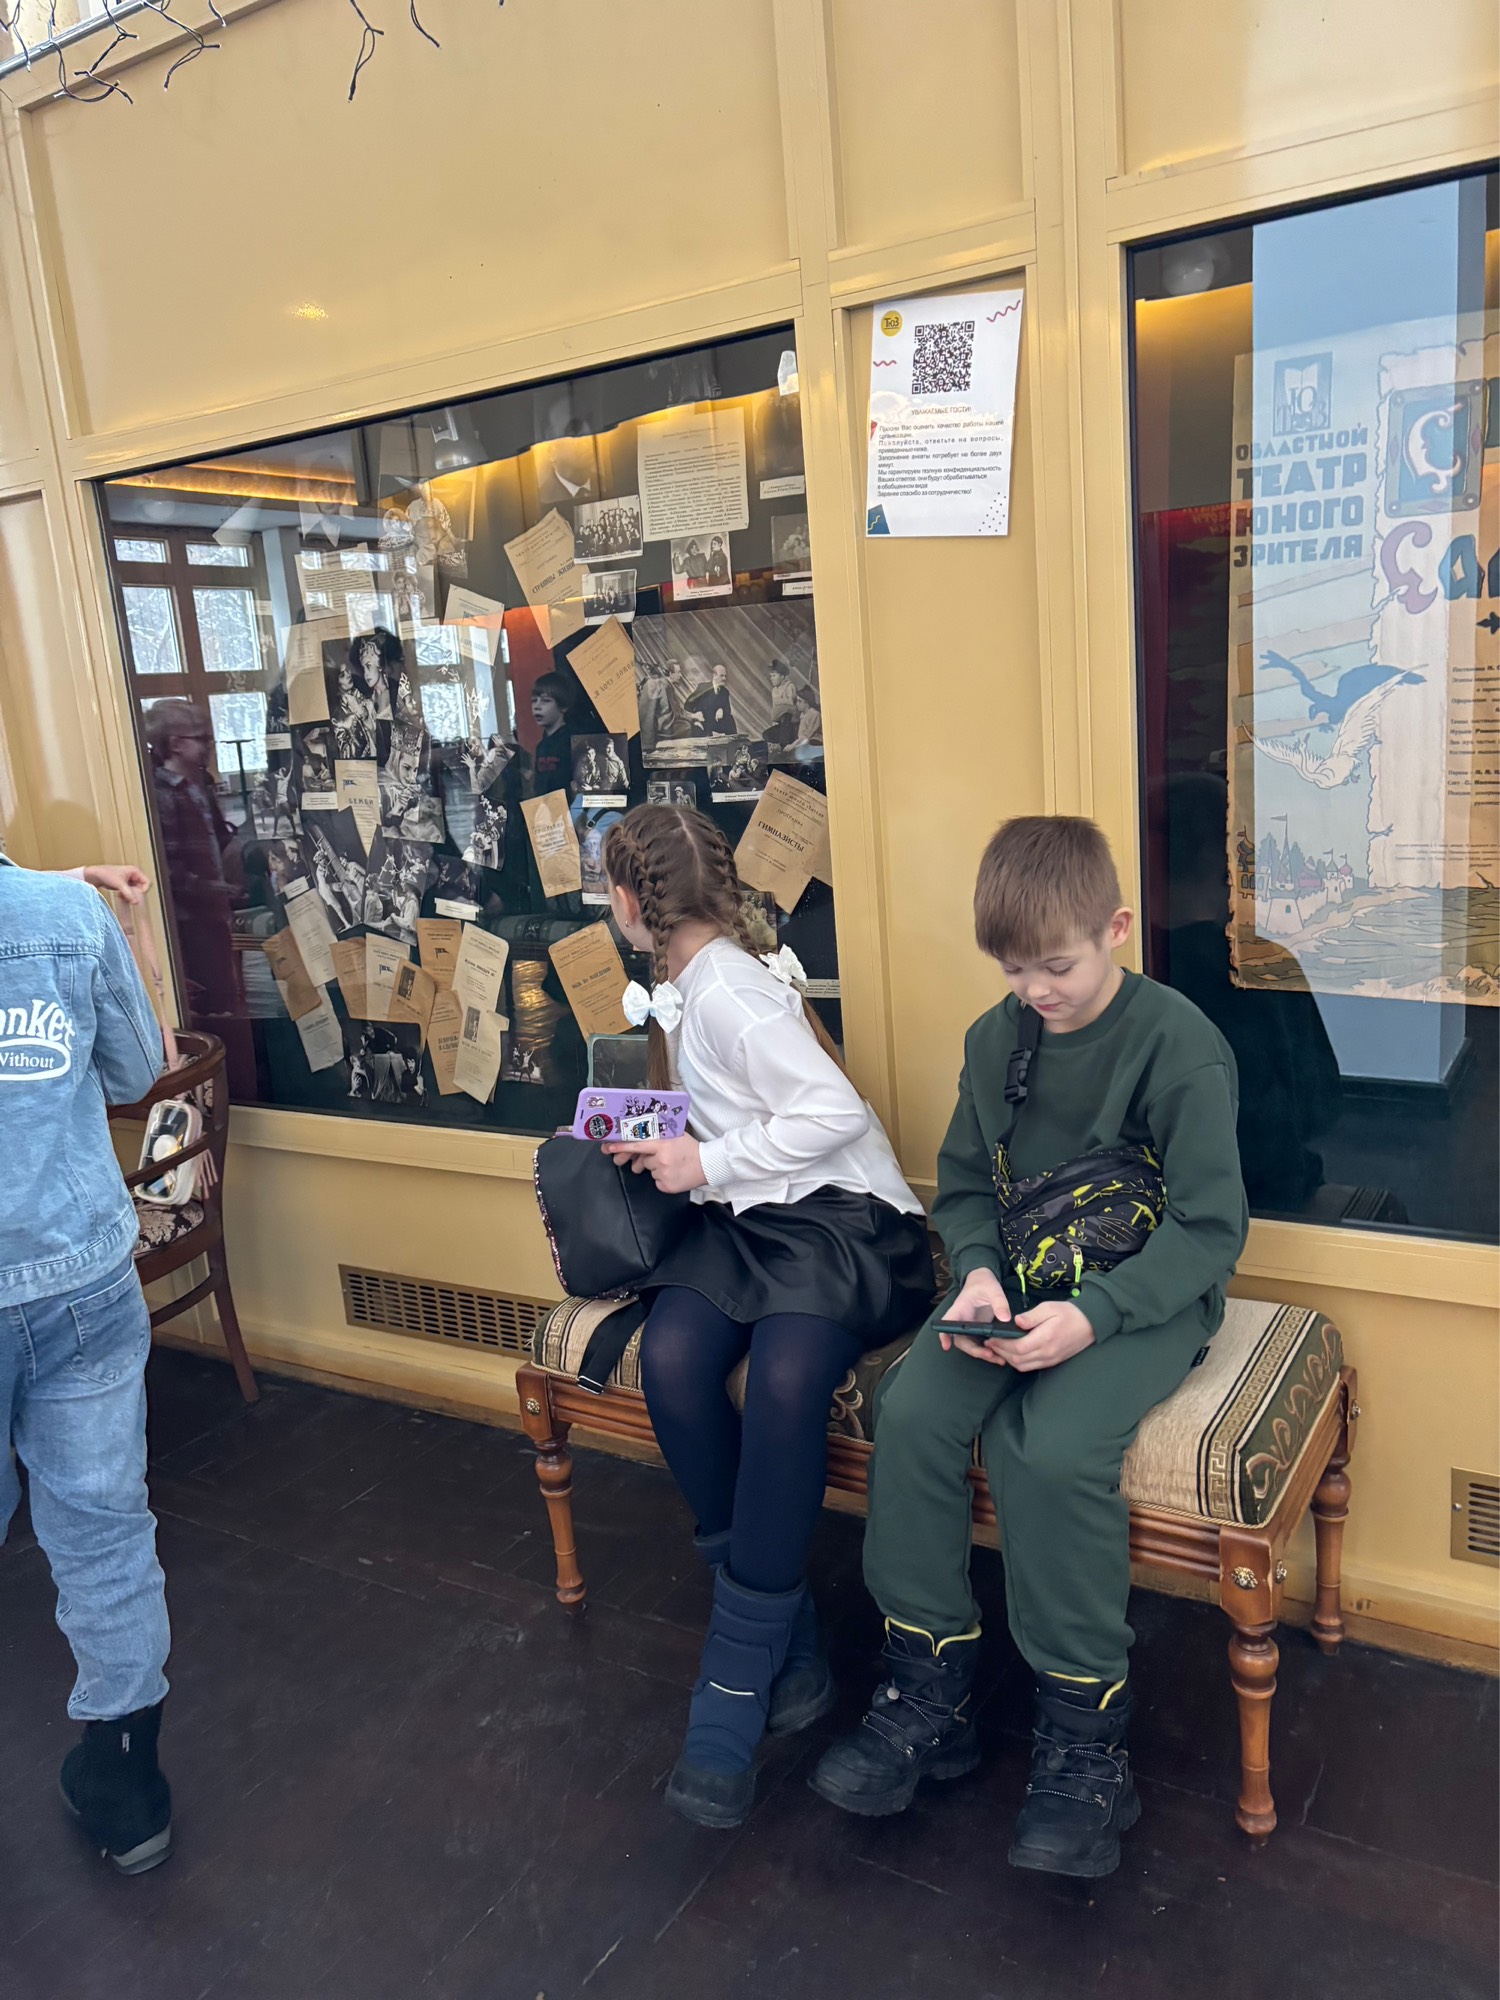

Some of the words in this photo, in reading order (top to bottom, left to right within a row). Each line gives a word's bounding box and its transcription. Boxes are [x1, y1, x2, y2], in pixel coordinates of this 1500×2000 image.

[1235, 422, 1368, 461] ОБЛАСТНОЙ
[1236, 452, 1367, 499] ТЕАТР
[1235, 495, 1364, 537] ЮНОГО
[1234, 534, 1363, 568] ЗРИТЕЛЯ
[757, 821, 804, 852] ГИМНАЗИСТЫ
